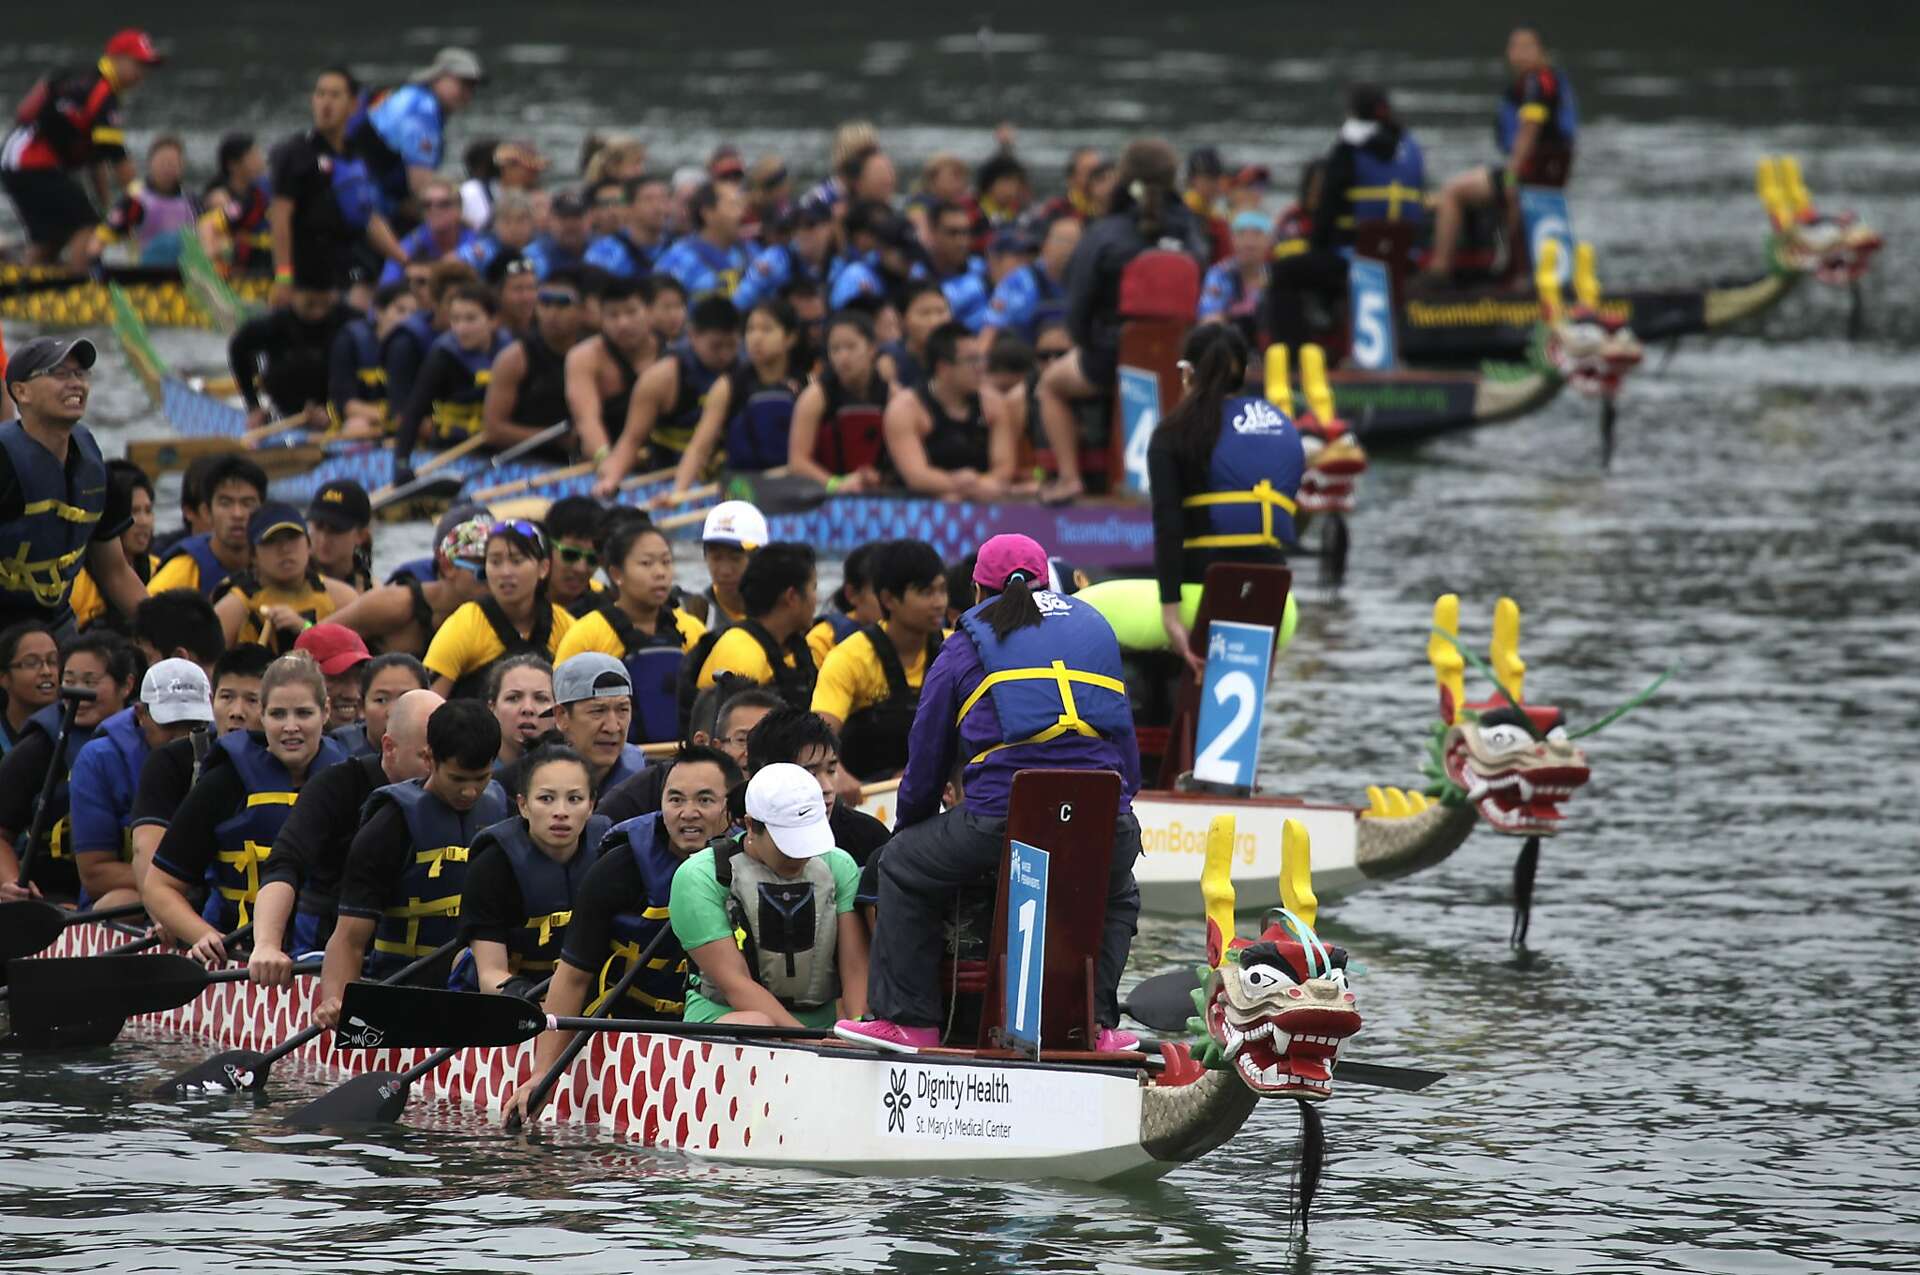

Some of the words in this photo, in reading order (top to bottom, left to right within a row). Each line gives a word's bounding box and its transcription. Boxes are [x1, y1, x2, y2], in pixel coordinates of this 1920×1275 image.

[1532, 217, 1570, 288] 6
[1353, 291, 1386, 368] 5
[1124, 408, 1152, 493] 4
[1193, 670, 1257, 785] 2
[1059, 804, 1072, 822] C
[1015, 899, 1037, 1031] 1
[917, 1070, 963, 1109] Dignity
[966, 1073, 1010, 1103] Health
[916, 1115, 925, 1133] St.
[927, 1116, 953, 1139] Mary's
[954, 1118, 984, 1137] Medical
[985, 1120, 1012, 1138] Center
